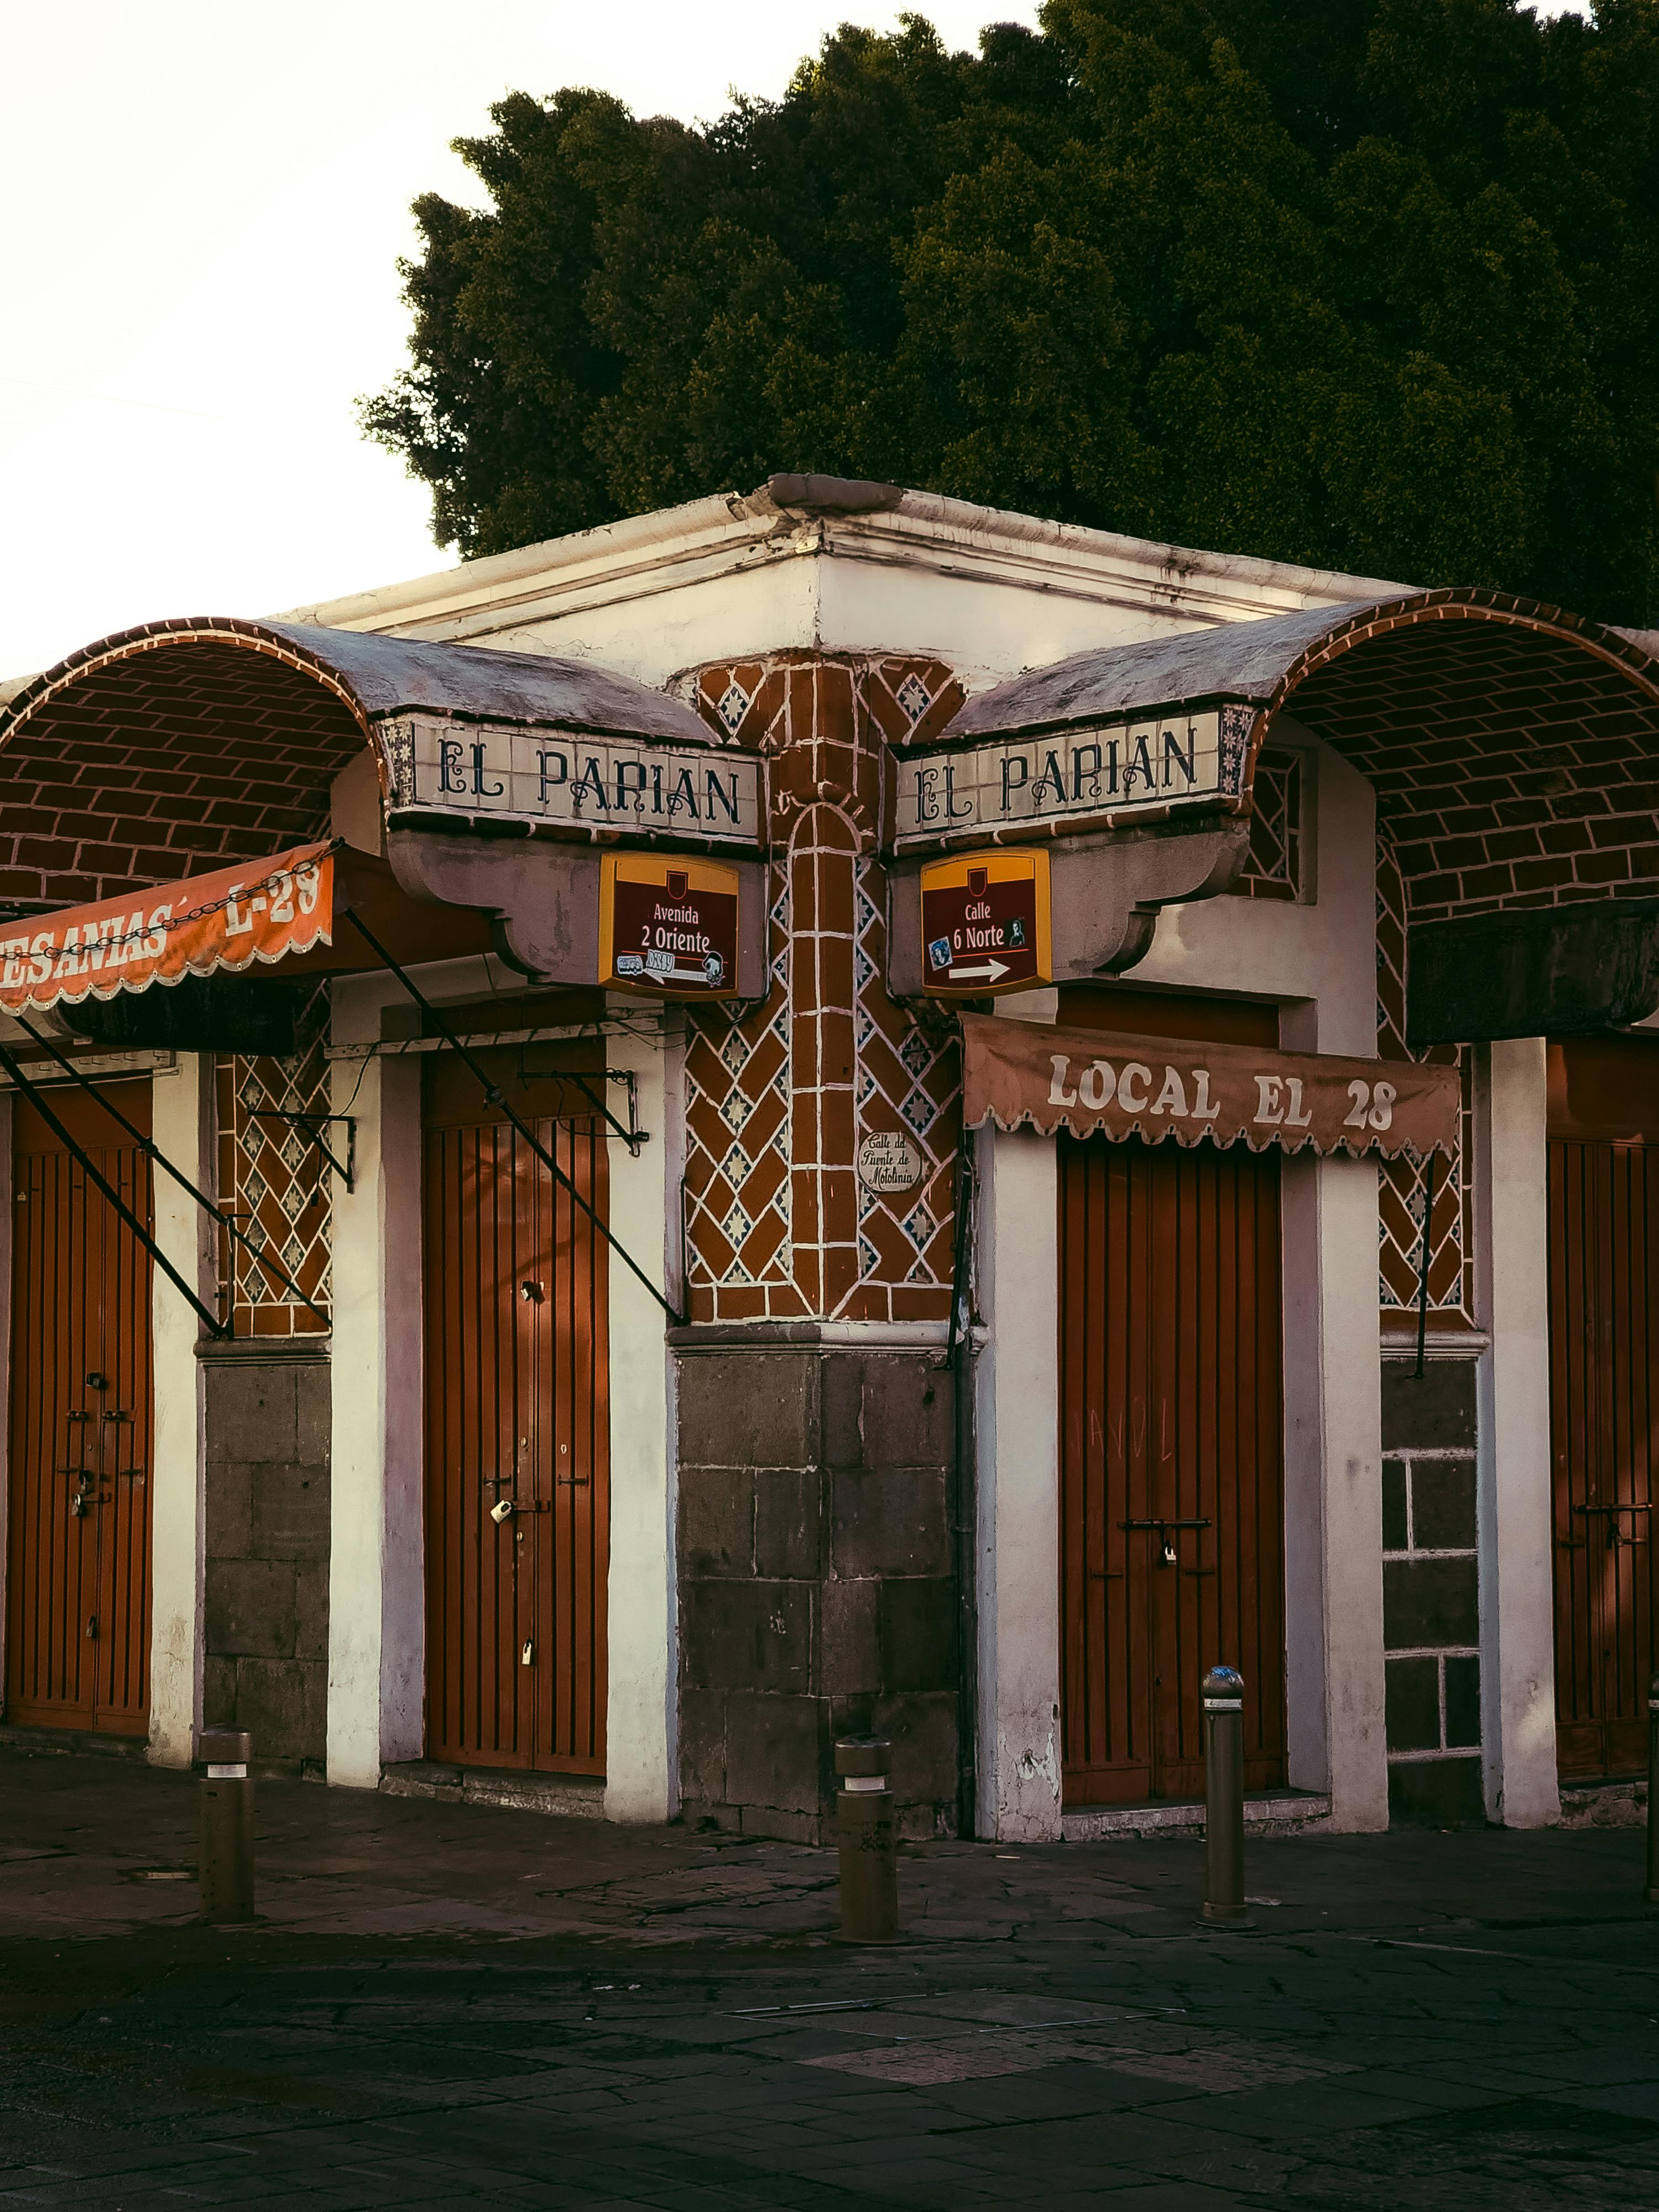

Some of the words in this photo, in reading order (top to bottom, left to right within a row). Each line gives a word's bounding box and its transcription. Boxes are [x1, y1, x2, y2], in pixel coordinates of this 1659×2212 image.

[437, 738, 504, 796] EL
[536, 749, 742, 826] PARIAN
[914, 765, 973, 824] EL
[999, 727, 1198, 812] PARIAN
[226, 863, 319, 937] L-28
[965, 902, 990, 920] Calle
[654, 903, 699, 924] Avenida
[641, 925, 650, 946] 2
[656, 927, 709, 953] Oriente
[953, 929, 961, 949] 6
[966, 925, 1004, 948] Norte
[1047, 1055, 1220, 1119] LOCAL
[1254, 1075, 1313, 1127] EL
[1343, 1079, 1397, 1130] 28
[867, 1133, 890, 1149] Calle
[861, 1150, 894, 1165] Puente
[897, 1150, 910, 1165] de
